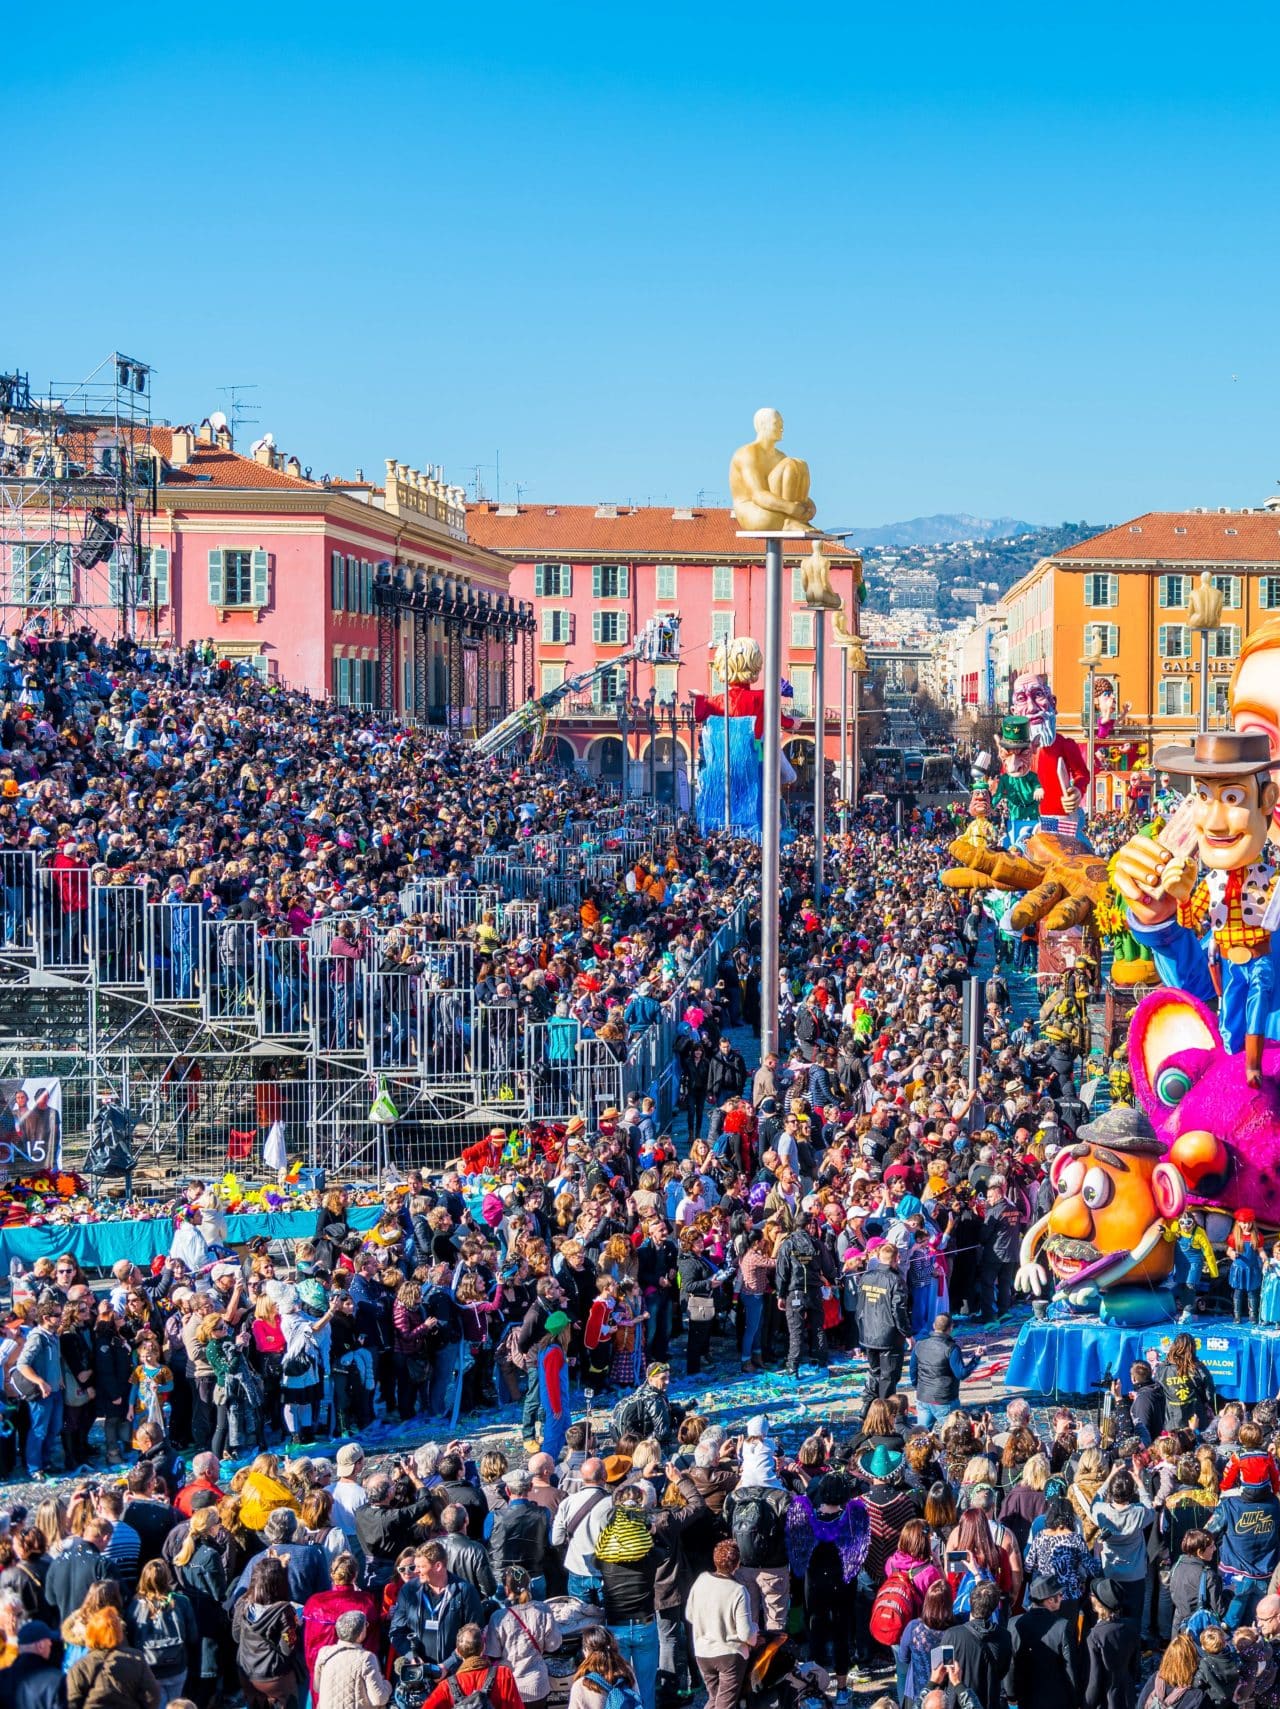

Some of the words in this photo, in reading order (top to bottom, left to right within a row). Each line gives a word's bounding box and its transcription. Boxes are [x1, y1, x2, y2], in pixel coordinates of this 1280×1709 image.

[1163, 662, 1235, 672] GALEIES
[1166, 1376, 1189, 1385] STAF
[1241, 1511, 1264, 1525] NIKE
[1254, 1520, 1273, 1534] AIR
